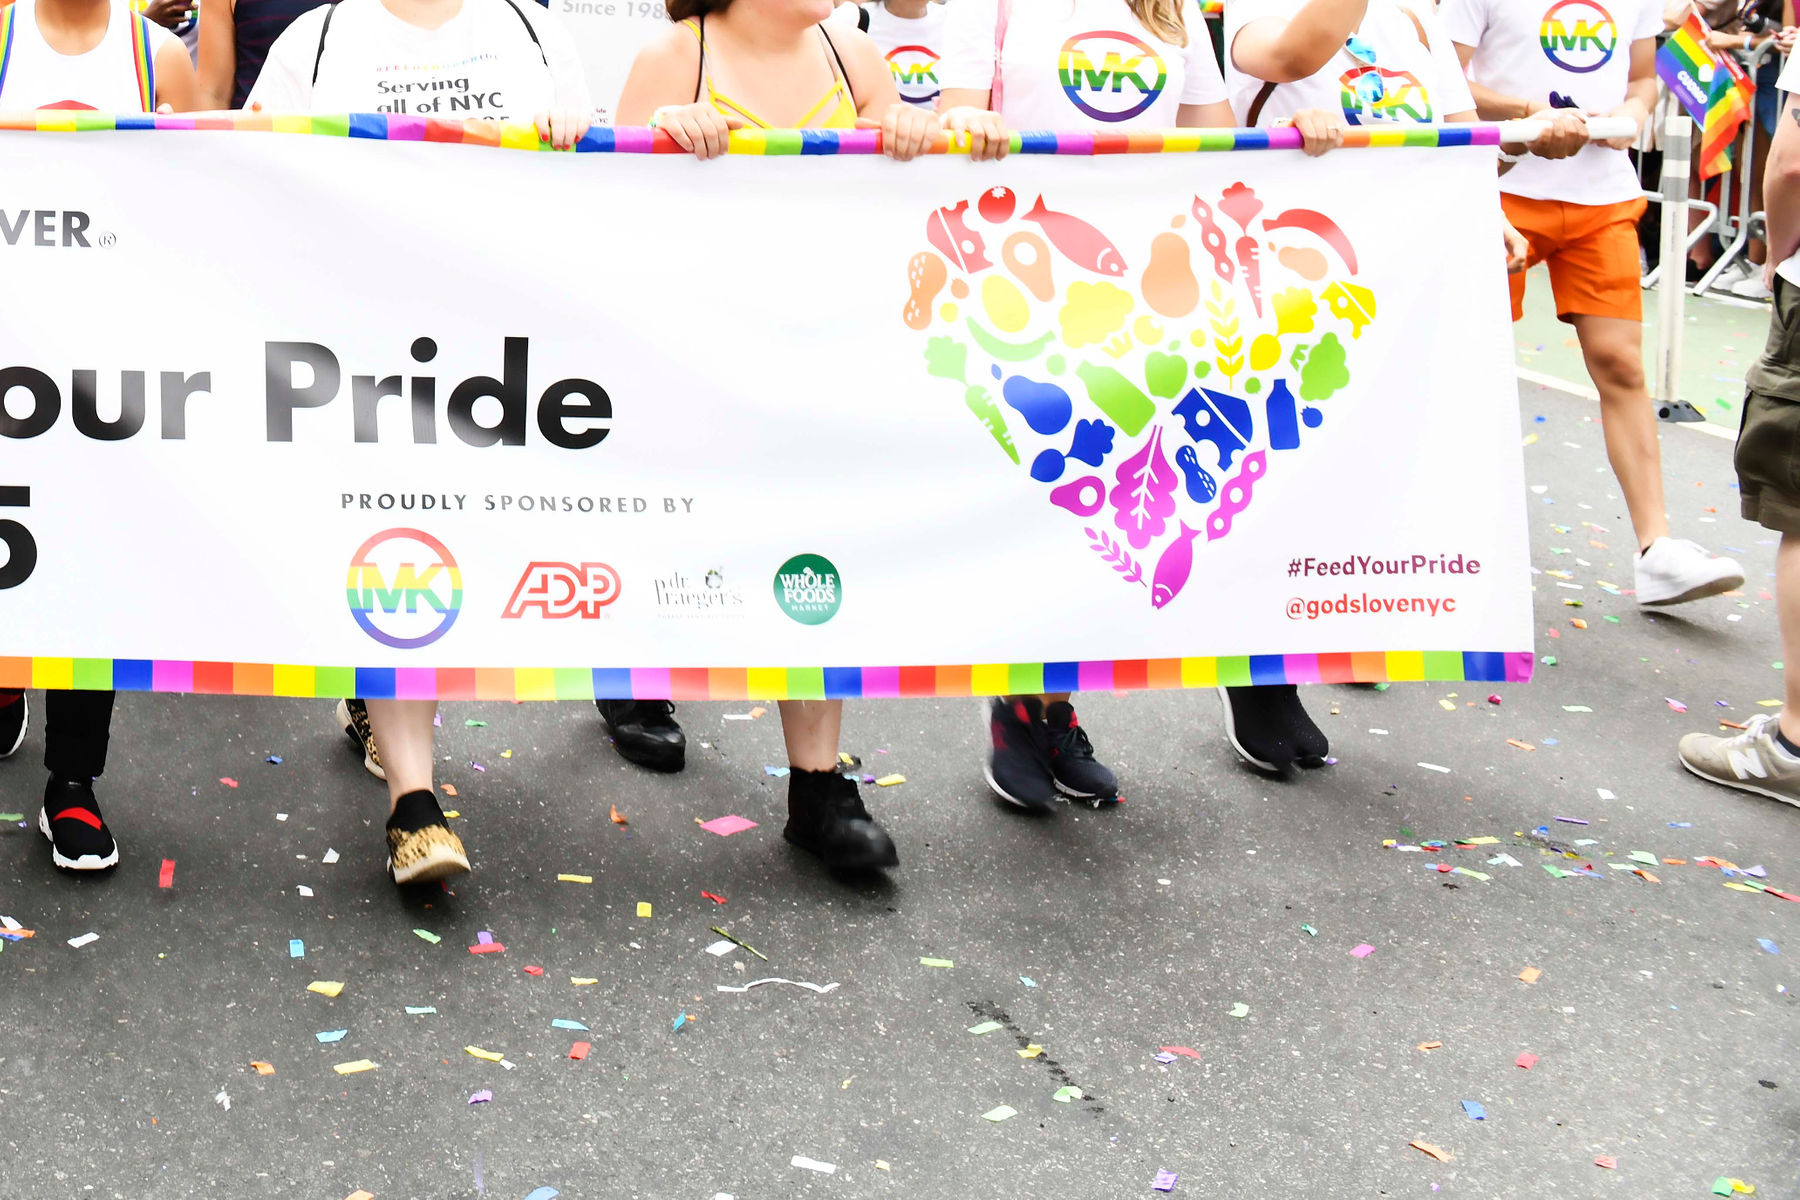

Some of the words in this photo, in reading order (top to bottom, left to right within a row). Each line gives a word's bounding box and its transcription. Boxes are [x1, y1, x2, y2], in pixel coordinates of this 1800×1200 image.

[627, 2, 666, 19] 198
[1550, 19, 1609, 51] MK
[1068, 50, 1162, 93] MK
[376, 76, 470, 94] Serving
[376, 99, 406, 114] all
[416, 96, 442, 113] of
[450, 92, 504, 111] NYC
[264, 337, 613, 450] Pride
[341, 493, 467, 512] PROUDLY
[484, 494, 649, 514] SPONSORED
[664, 496, 695, 513] BY
[1287, 554, 1481, 578] #FeedYourPride
[500, 561, 622, 619] ADP
[779, 572, 835, 589] WHOLE
[783, 588, 836, 604] FOODS
[1286, 593, 1457, 620] @godslovenyc
